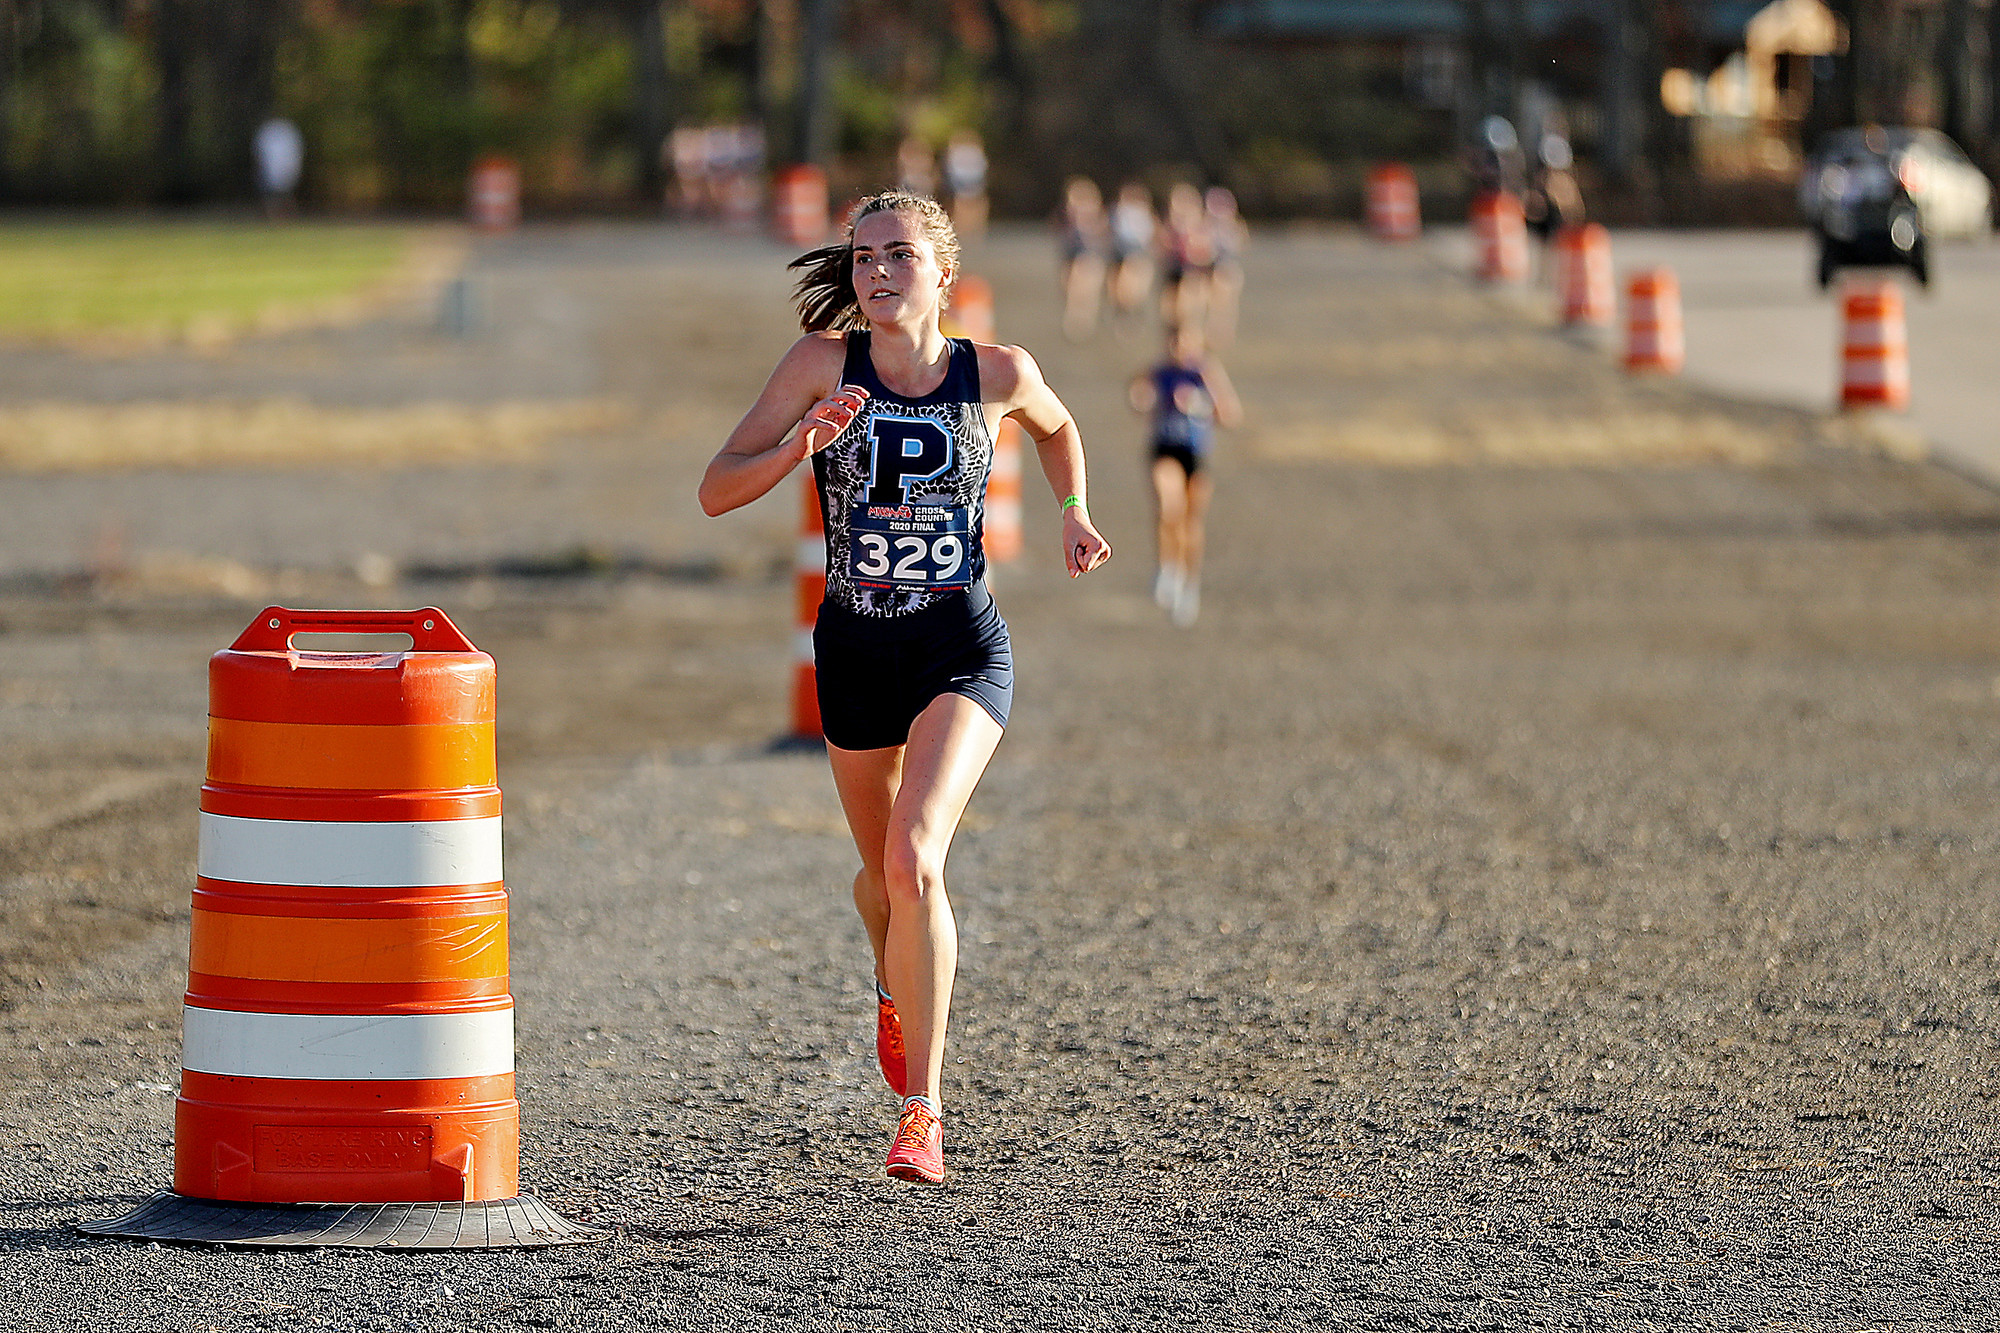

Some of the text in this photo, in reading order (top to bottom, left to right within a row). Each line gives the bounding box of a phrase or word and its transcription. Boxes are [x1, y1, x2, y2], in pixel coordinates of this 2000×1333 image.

[865, 413, 952, 505] P
[889, 521, 936, 531] 2020 FINAL
[856, 533, 964, 581] 329
[258, 1131, 303, 1147] FOR
[277, 1152, 336, 1168] BASE
